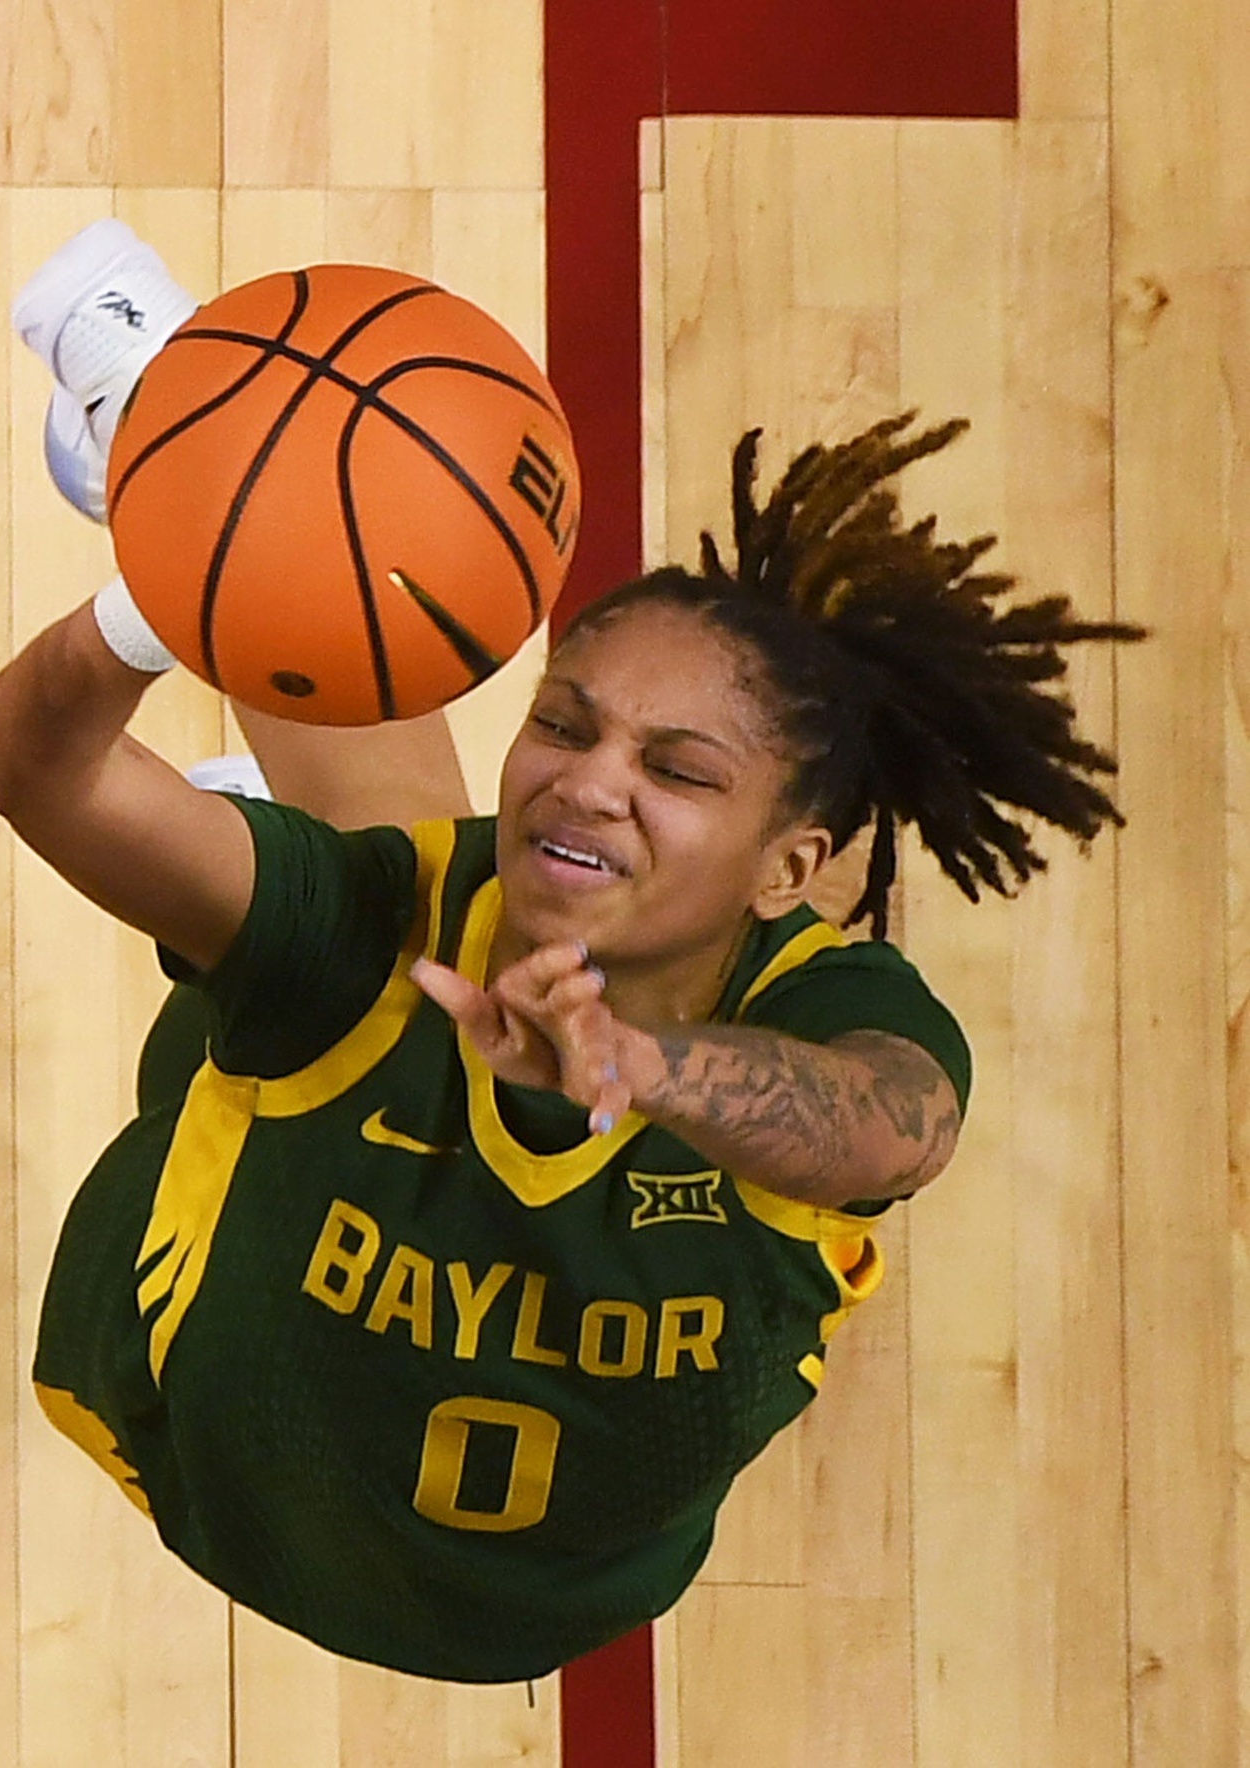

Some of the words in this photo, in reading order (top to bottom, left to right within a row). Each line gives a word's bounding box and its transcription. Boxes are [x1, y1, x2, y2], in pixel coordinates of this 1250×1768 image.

[626, 1170, 728, 1230] XII
[301, 1198, 725, 1379] BAYLOR
[412, 1395, 561, 1533] 0
